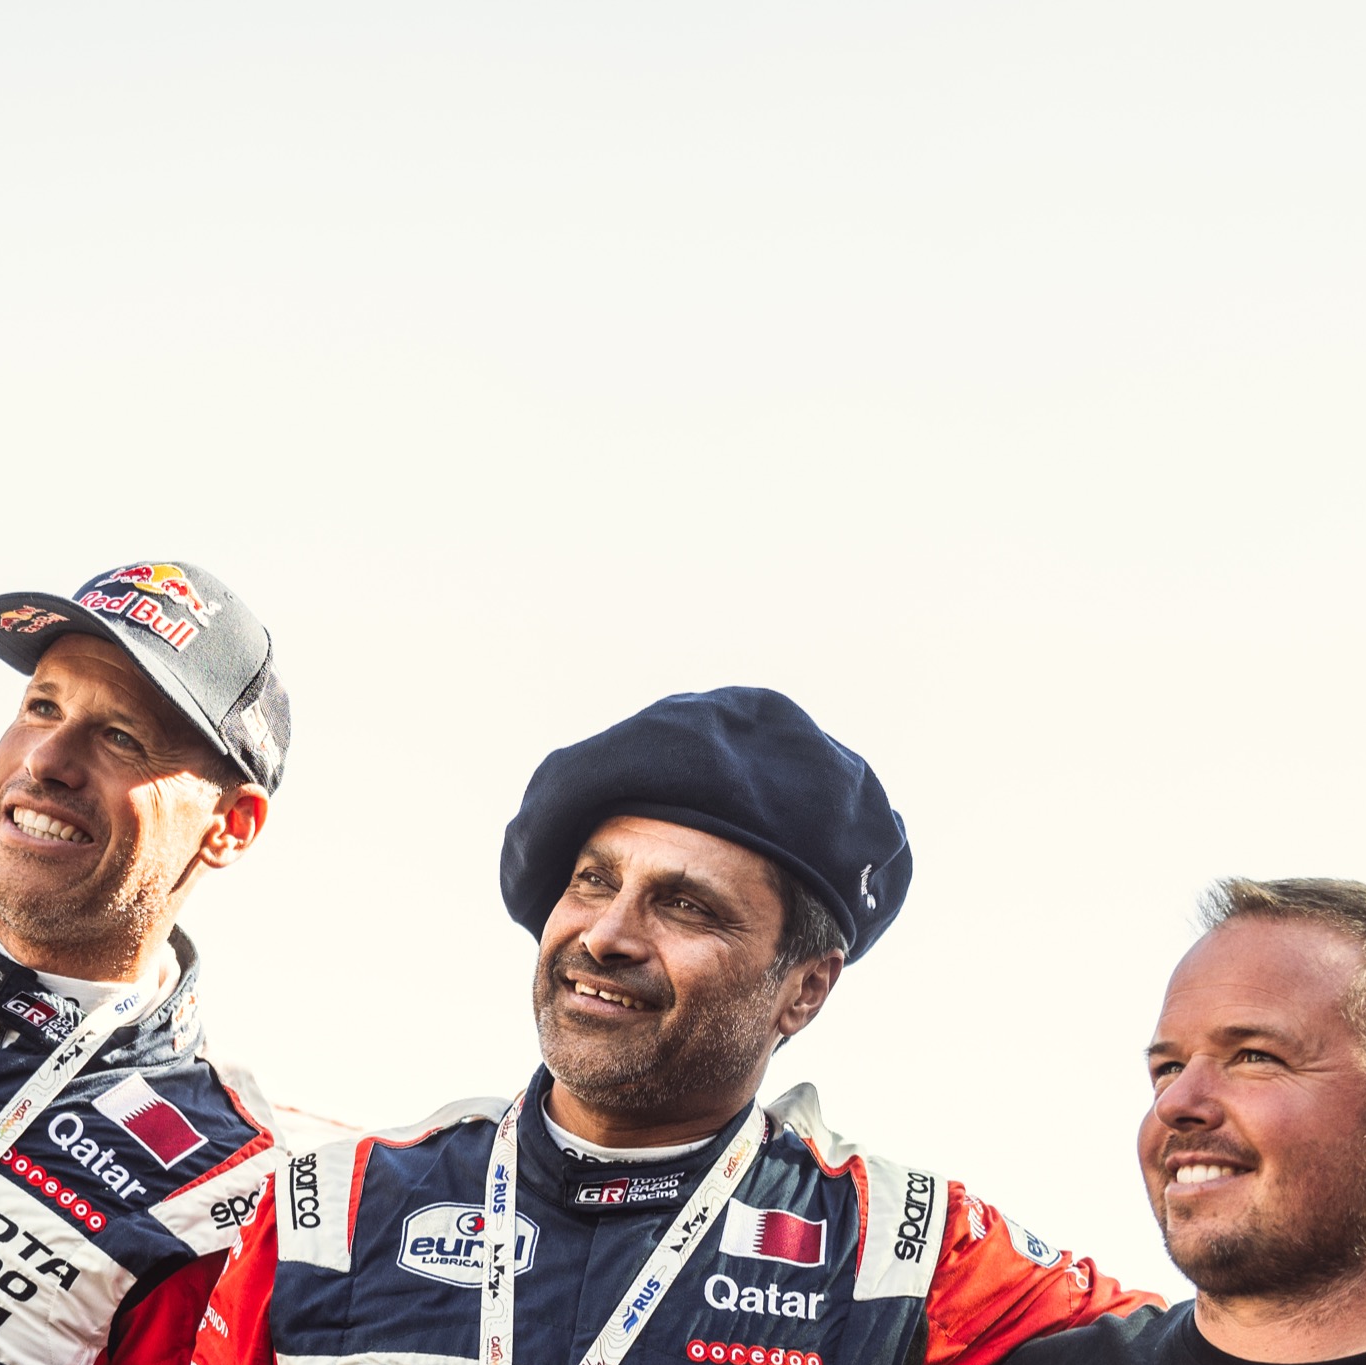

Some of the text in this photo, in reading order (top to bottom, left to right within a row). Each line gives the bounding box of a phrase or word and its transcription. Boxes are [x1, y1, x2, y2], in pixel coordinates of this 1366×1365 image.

[79, 591, 199, 652] Red Bull
[6, 999, 49, 1025] GR
[47, 1112, 146, 1201] Qatar
[0, 1146, 107, 1232] ooredoo
[288, 1152, 321, 1230] sparco
[493, 1182, 508, 1215] RUS
[578, 1187, 624, 1203] GR
[626, 1188, 679, 1203] Racing
[628, 1179, 679, 1194] GAZOO
[893, 1171, 935, 1265] sparco
[409, 1234, 526, 1259] eurl
[421, 1256, 485, 1269] LUBRICA
[632, 1278, 661, 1312] RUS
[703, 1273, 825, 1320] Qatar
